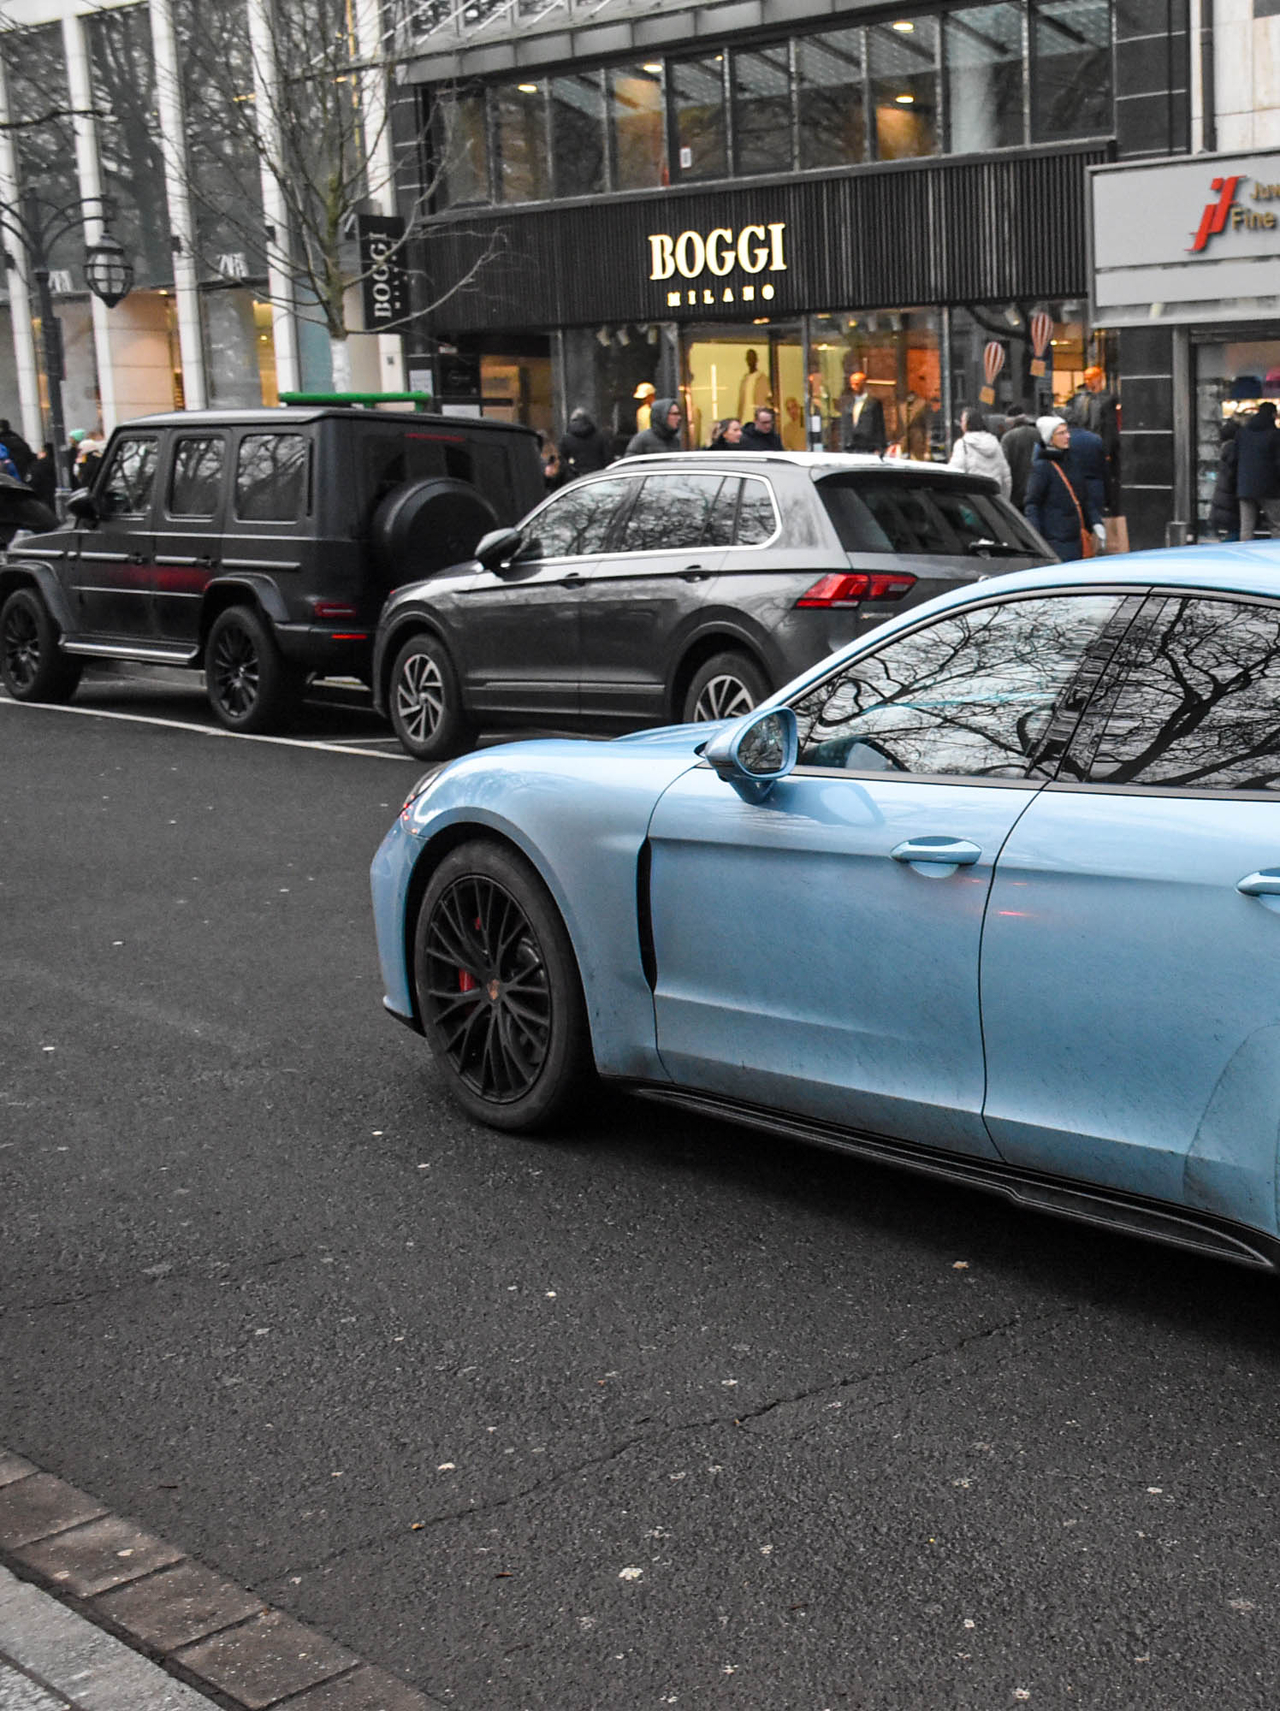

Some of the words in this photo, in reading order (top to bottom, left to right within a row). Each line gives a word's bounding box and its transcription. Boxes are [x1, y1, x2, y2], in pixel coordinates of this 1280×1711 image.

[1231, 206, 1276, 231] Fine
[648, 222, 788, 281] BOGGI
[368, 232, 393, 318] BOGGI
[667, 283, 775, 307] MILANO
